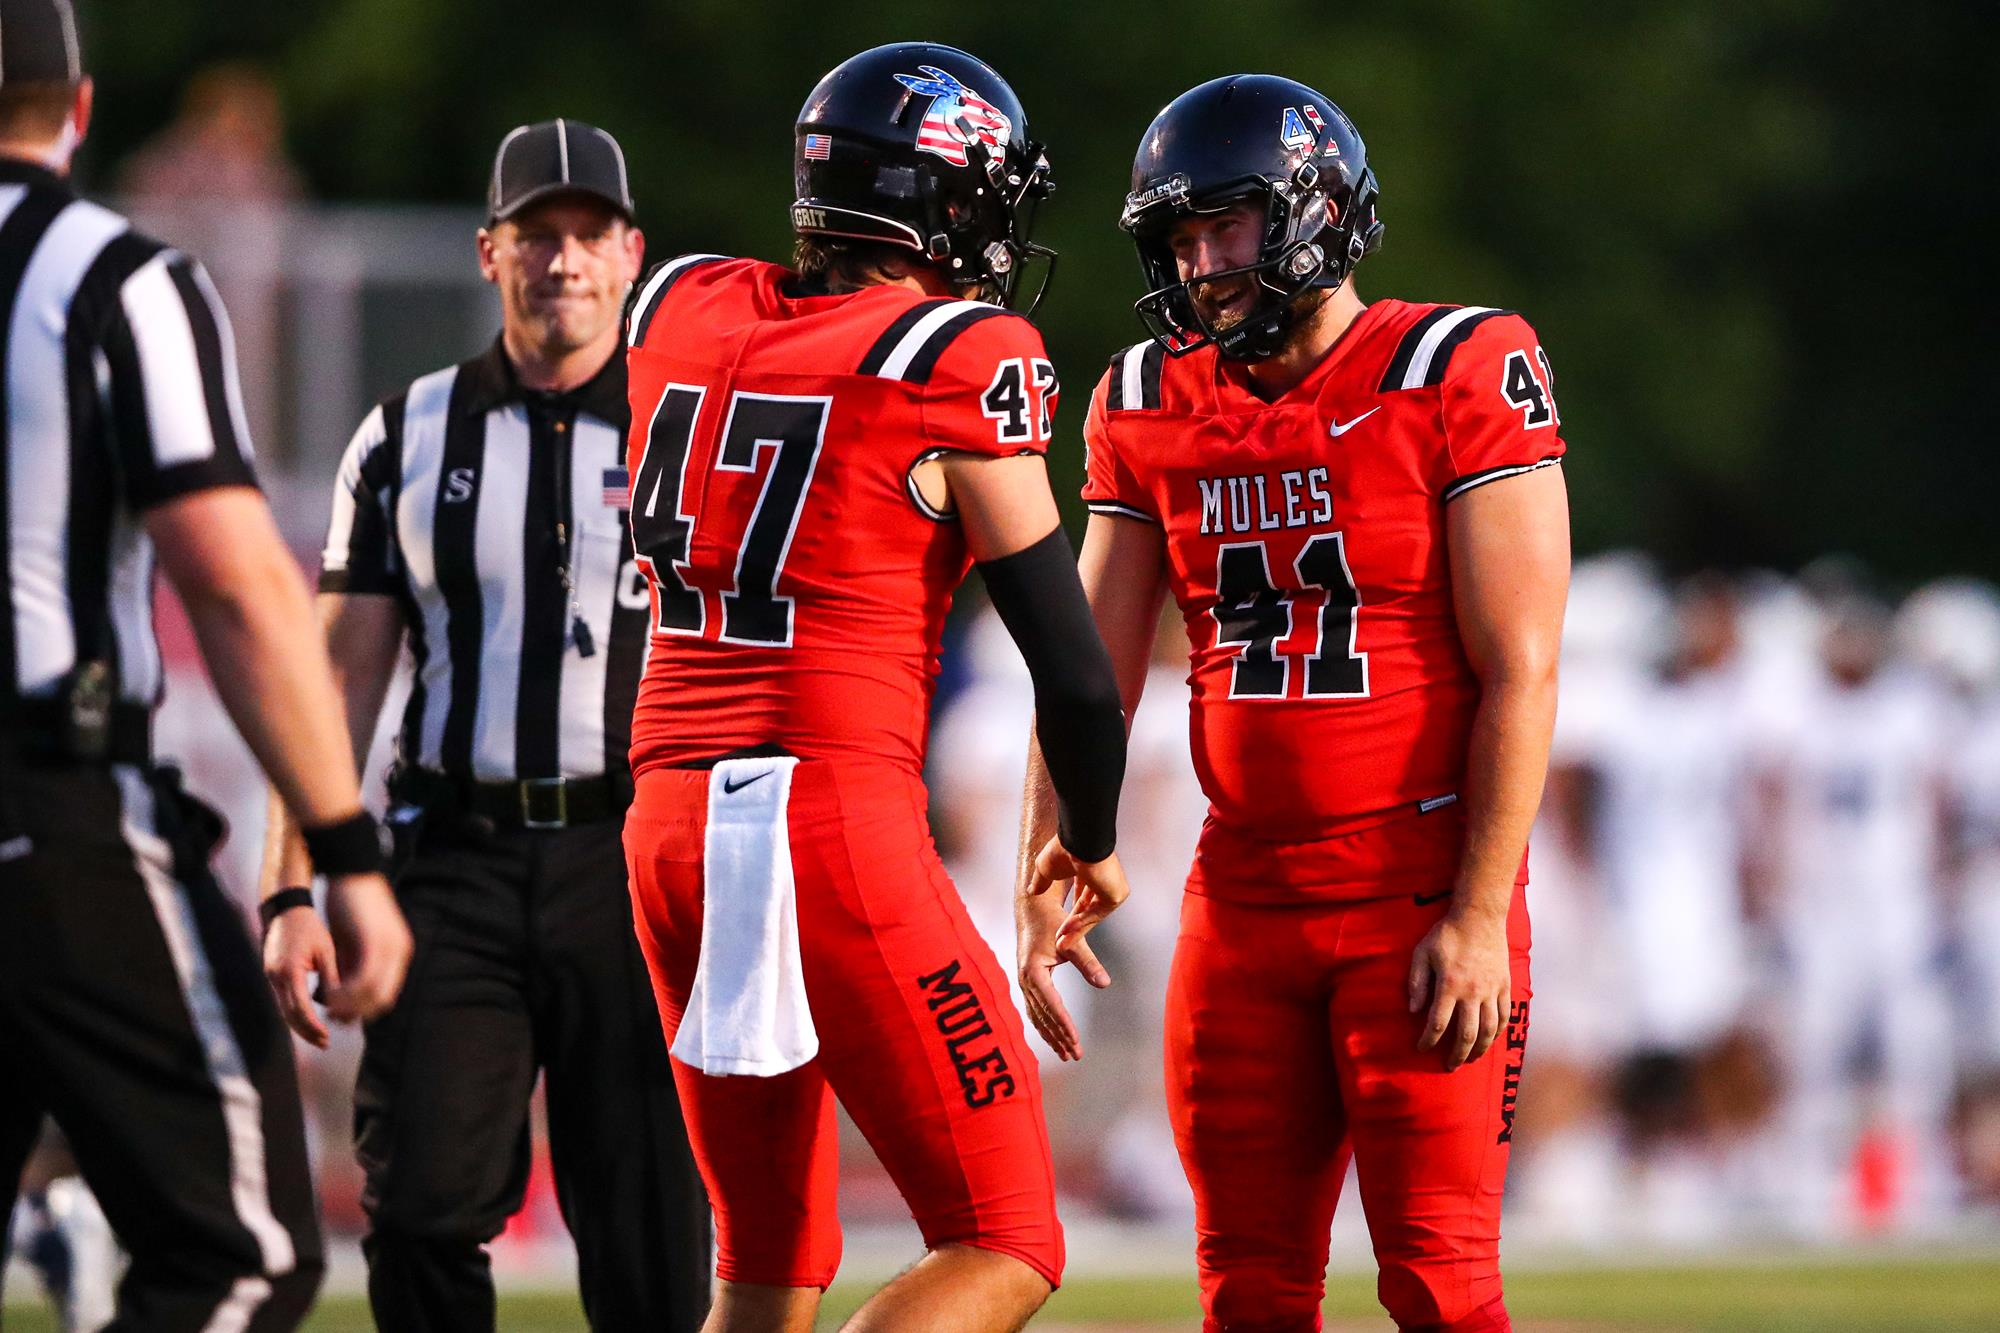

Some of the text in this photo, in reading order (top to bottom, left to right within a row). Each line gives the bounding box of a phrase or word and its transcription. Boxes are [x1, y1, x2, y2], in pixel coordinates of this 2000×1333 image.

[1281, 105, 1340, 160] 41
[795, 207, 826, 228] GRIT
[979, 357, 1060, 444] 47
[444, 467, 475, 503] S
[629, 382, 834, 649] 47
[1199, 466, 1333, 536] MULES
[1209, 530, 1371, 701] 41
[917, 959, 1016, 1109] MULES
[1496, 1000, 1529, 1146] MULES
